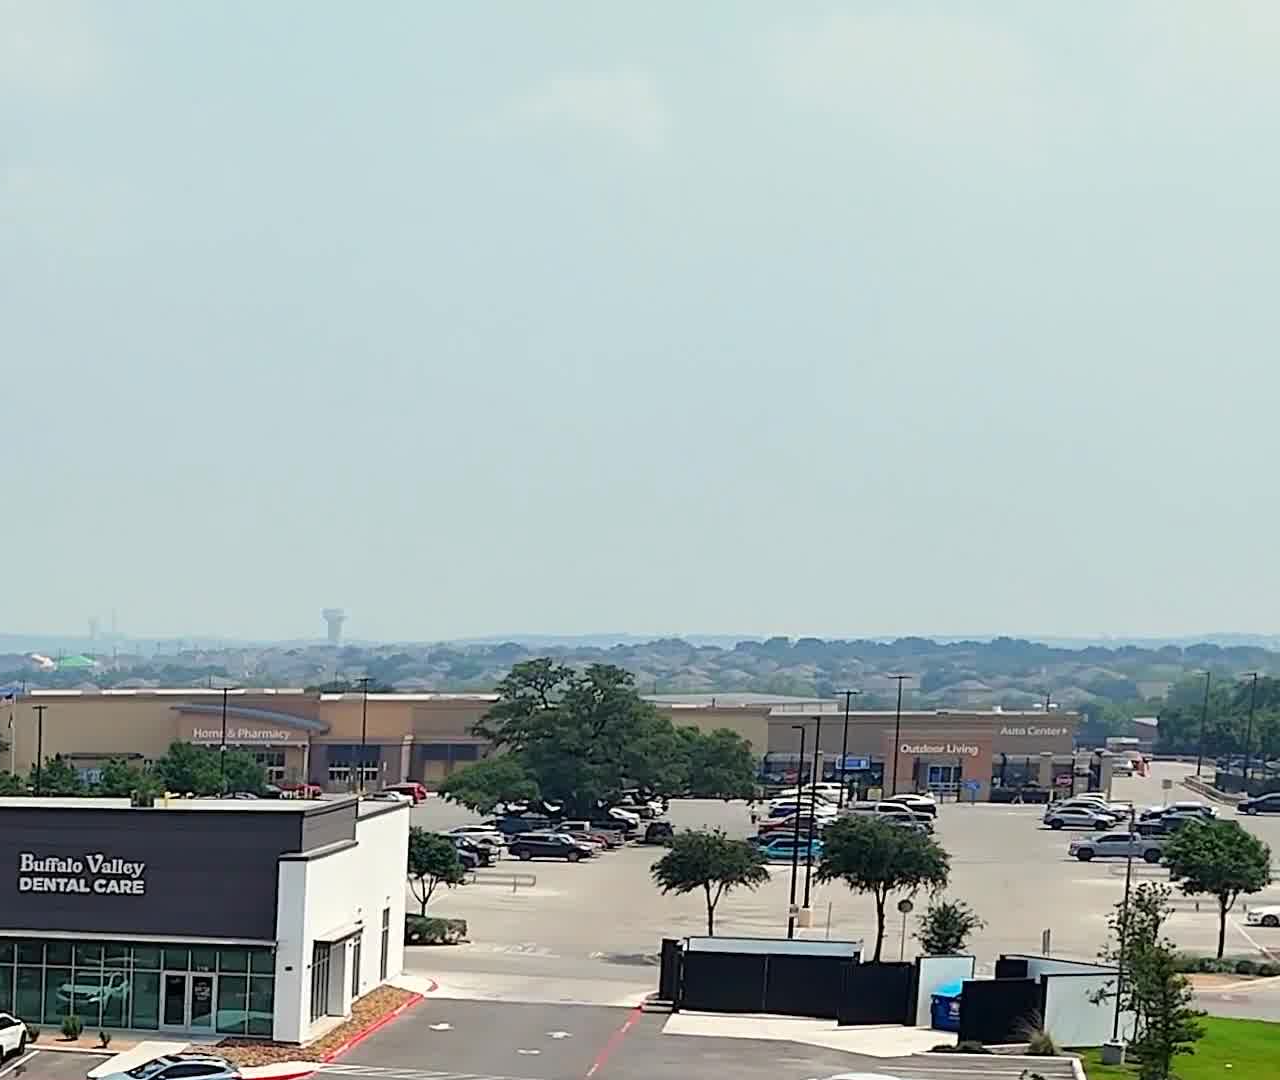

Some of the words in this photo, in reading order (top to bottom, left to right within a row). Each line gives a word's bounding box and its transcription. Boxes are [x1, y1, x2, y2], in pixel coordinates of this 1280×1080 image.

[238, 728, 290, 739] Pharmacy
[1000, 727, 1026, 736] Auto
[900, 744, 944, 754] Outdoor
[947, 744, 979, 756] Living
[19, 853, 83, 873] Buffalo
[85, 854, 145, 878] Valley
[19, 877, 91, 892] DENTAL
[93, 879, 145, 894] CARE
